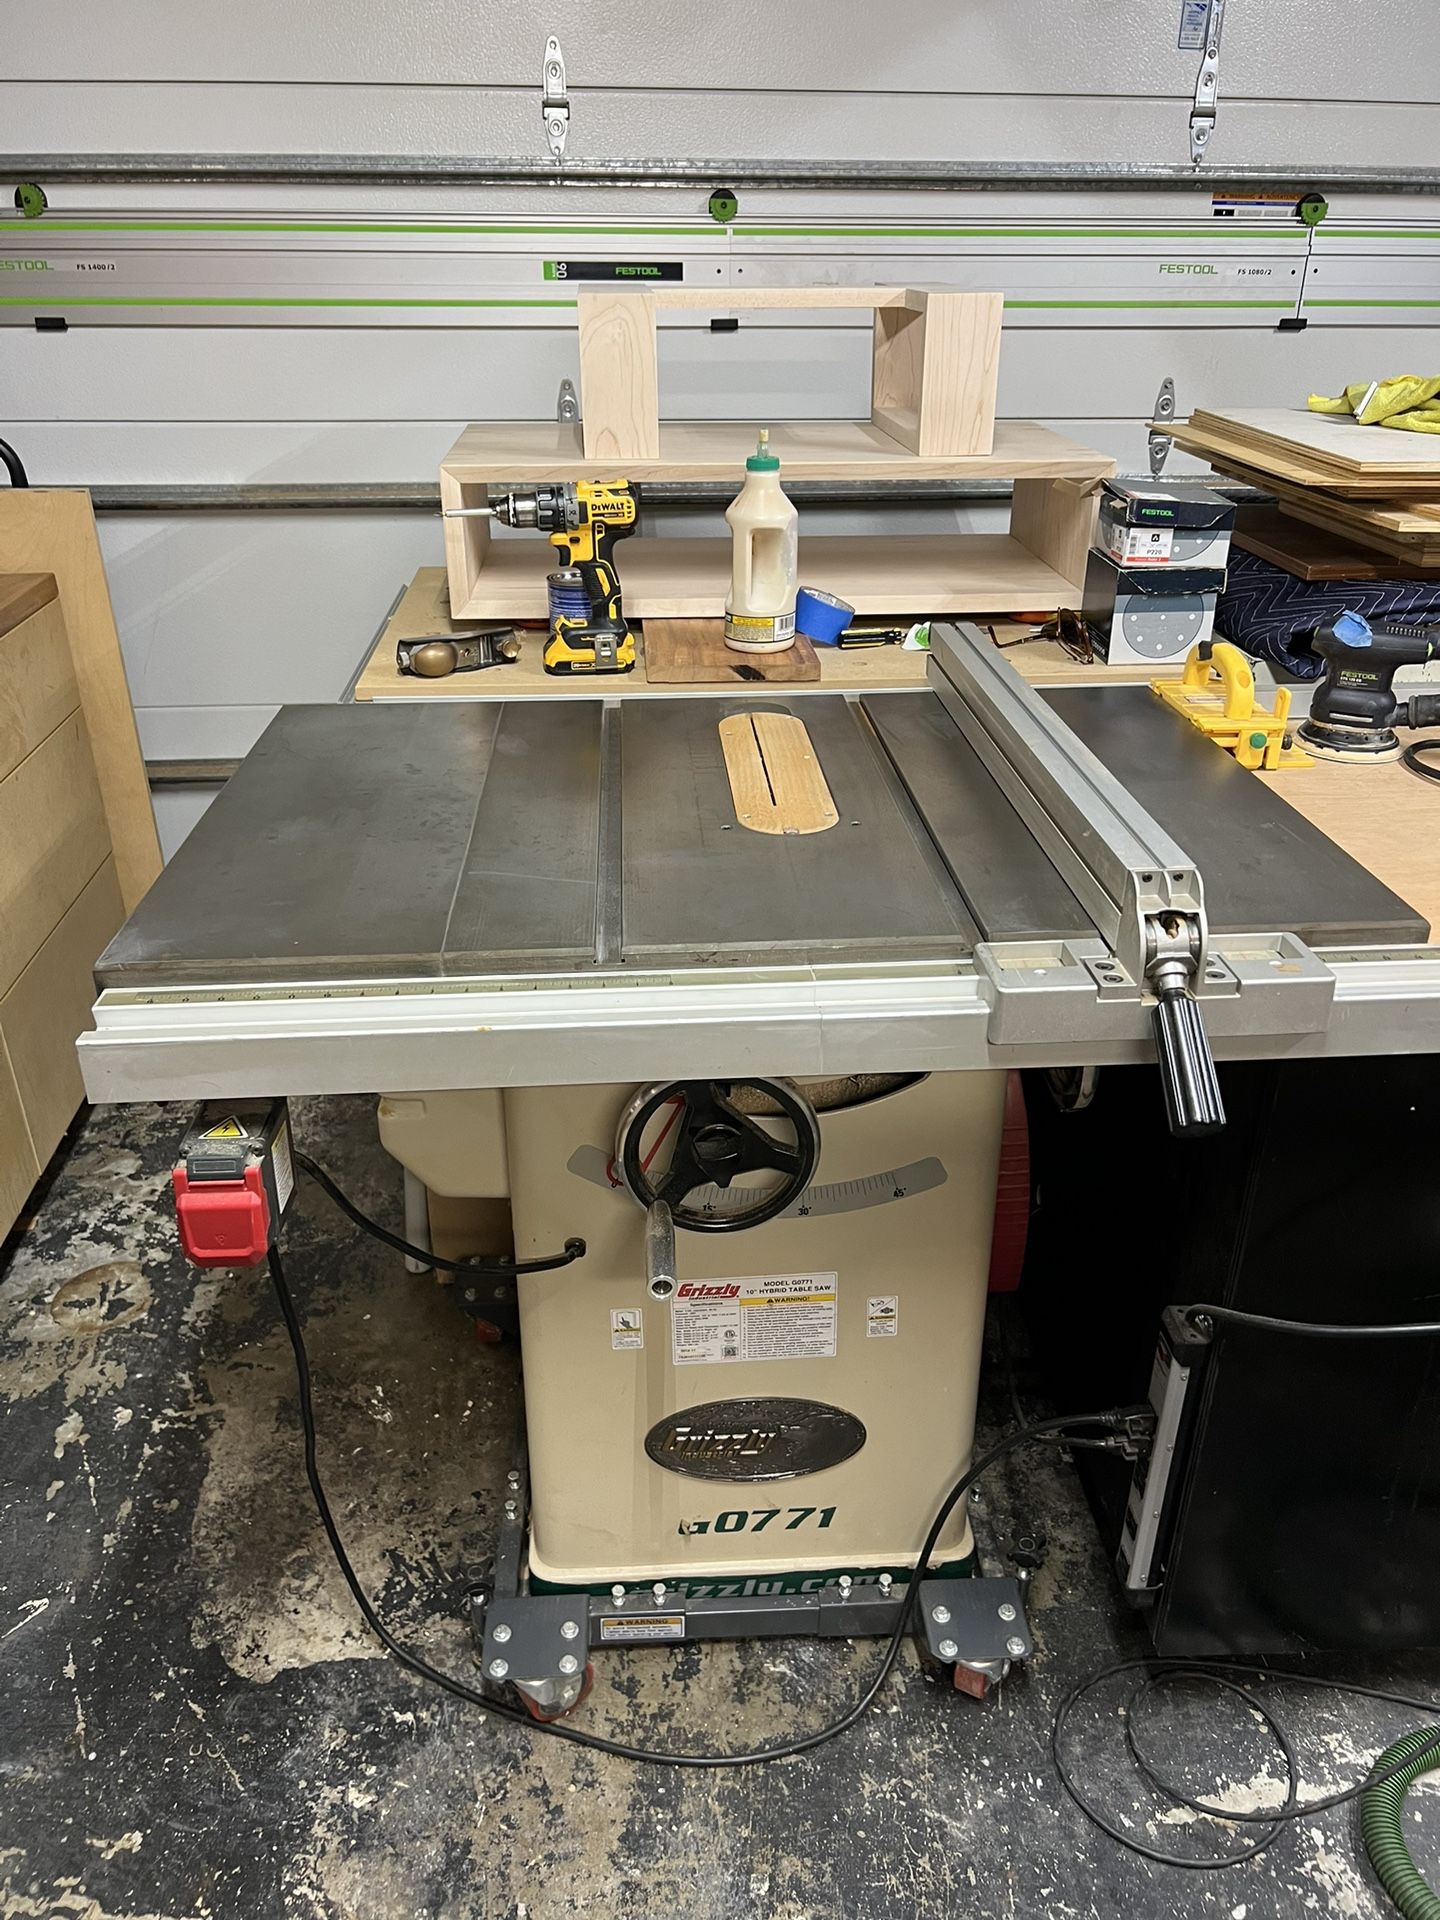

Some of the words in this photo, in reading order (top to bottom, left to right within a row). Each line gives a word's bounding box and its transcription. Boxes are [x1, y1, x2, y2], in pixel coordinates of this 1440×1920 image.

[615, 267, 662, 276] FESTOOL
[1159, 264, 1218, 275] FESTOOL
[1237, 268, 1246, 276] FS
[1248, 268, 1272, 276] 1080/2
[1141, 508, 1175, 517] FESTOOL
[1340, 671, 1379, 681] FESTOOL
[677, 1283, 741, 1299] Grizzly
[774, 1296, 811, 1304] WARNING!
[662, 1427, 777, 1456] Grizzly
[625, 1618, 669, 1626] WARNING
